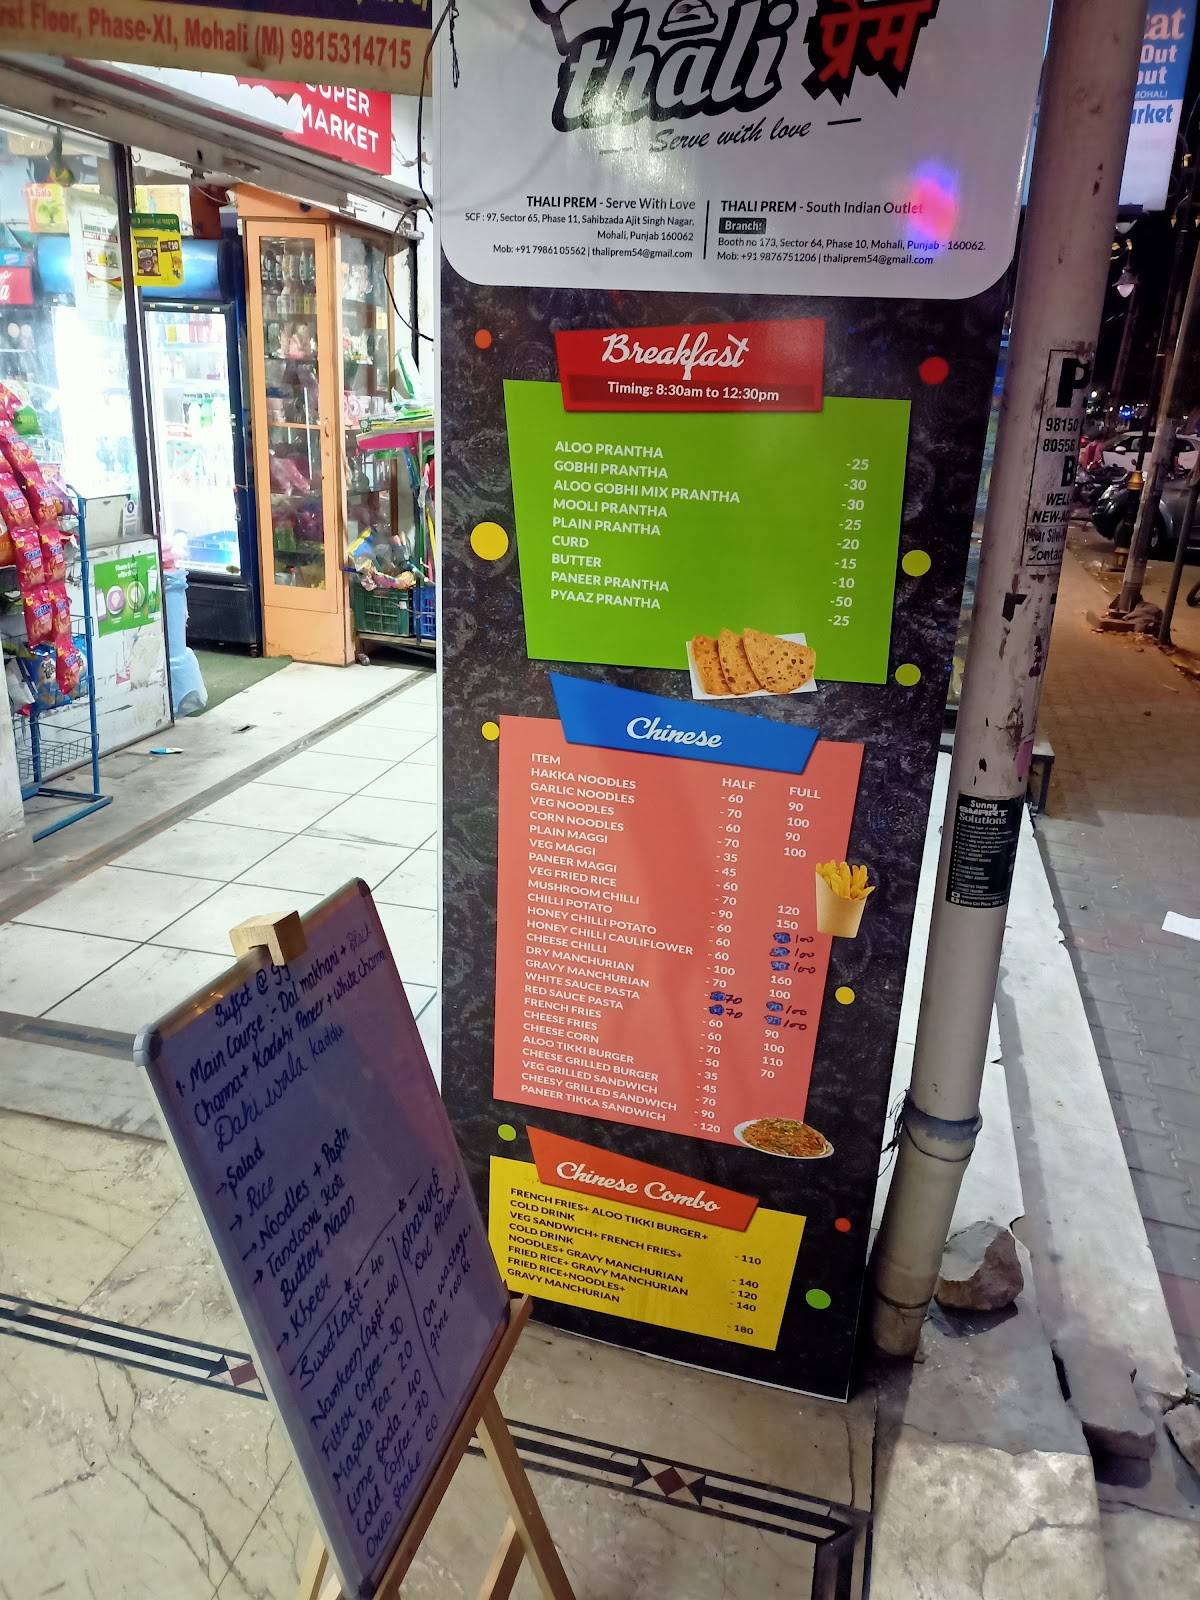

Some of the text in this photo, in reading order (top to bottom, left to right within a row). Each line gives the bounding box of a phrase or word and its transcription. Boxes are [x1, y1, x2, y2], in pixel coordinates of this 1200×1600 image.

[31, 3, 412, 69] Floor, Phase-XI, Mohali (M) 9815314715
[818, 0, 934, 83] प्रेम
[556, 0, 798, 128] thali
[300, 103, 379, 153] MARKET
[652, 117, 812, 153] Serve with love
[526, 195, 696, 210] THALI PREM Serve With Love
[720, 200, 924, 214] THALI PREM South Indian Outlet
[465, 212, 481, 221] SCF
[500, 213, 526, 222] Sector
[527, 213, 540, 223] 65,
[542, 213, 566, 223] Phase
[582, 214, 624, 225] Sahibzada
[625, 215, 641, 226] Ajit
[642, 215, 665, 227] Singh
[667, 216, 695, 227] Nagar,
[597, 230, 694, 242] Mohali, Punjab 160062
[718, 237, 744, 247] Booth
[745, 239, 758, 247] no
[759, 238, 778, 248] 173,
[779, 238, 809, 248] Sector
[810, 238, 824, 249] 64,
[826, 239, 853, 249] Phase
[855, 239, 869, 249] 10,
[870, 239, 905, 250] Mohali,
[907, 240, 940, 252] Punjab
[492, 243, 514, 253] Mob:
[591, 246, 693, 260] thaliprem54@gmail.com
[717, 251, 934, 266] Mob: +91 9876751206 thaliprem54@gmail.com
[602, 331, 750, 381] Breakfast
[607, 380, 780, 402] Timing: 8:30am to 12:30pm
[554, 440, 664, 459] ALOO PRANTHA
[553, 460, 668, 479] GOBHI PRANTHA
[846, 458, 869, 471] -25
[553, 479, 741, 503] ALOO GOBHI MIX PRANTHA
[843, 478, 867, 491] -30
[552, 498, 668, 517] MOOLI PRANTHA
[841, 499, 865, 511] -30
[552, 516, 661, 536] PLAIN PRANTHA
[839, 519, 862, 531] -25
[551, 535, 589, 548] CURD
[836, 538, 860, 550] -20
[551, 553, 602, 568] BUTTER
[834, 558, 857, 570] -15
[550, 571, 669, 592] PANEER PRANTHA
[832, 577, 855, 589] -10
[550, 589, 661, 609] PYAAZ PRANTHA
[830, 596, 853, 608] -50
[827, 615, 850, 627] -25
[626, 716, 723, 748] Chinese
[531, 752, 561, 765] ITEM
[530, 767, 637, 790] HAKKA NOODLES
[721, 777, 757, 790] HALF
[530, 782, 636, 804] GARLIC NOODLES
[789, 786, 821, 799] FULL
[788, 802, 804, 812] 90
[970, 799, 998, 810] Sunny
[787, 817, 810, 828] 100
[959, 812, 1007, 825] Solutions
[785, 832, 801, 842] 90
[783, 847, 807, 858] 100
[528, 852, 617, 873] PANEER MAGGI
[528, 865, 617, 888] VEG FRIED RICE
[527, 879, 640, 904] MUSHROOM CHILLI
[524, 971, 641, 1000] WHITE SAUCE PASTA
[521, 1084, 666, 1122] PANEER TIKKA SANDWICH
[556, 1161, 721, 1213] Chinese Combo
[258, 1179, 310, 1250] Noodles
[509, 1199, 576, 1221] COLD DRINK
[510, 1187, 709, 1240] FRENCH FRIES+ ALOO TIKKI BURGER+
[371, 1254, 385, 1275] 40
[407, 1368, 422, 1398] 40
